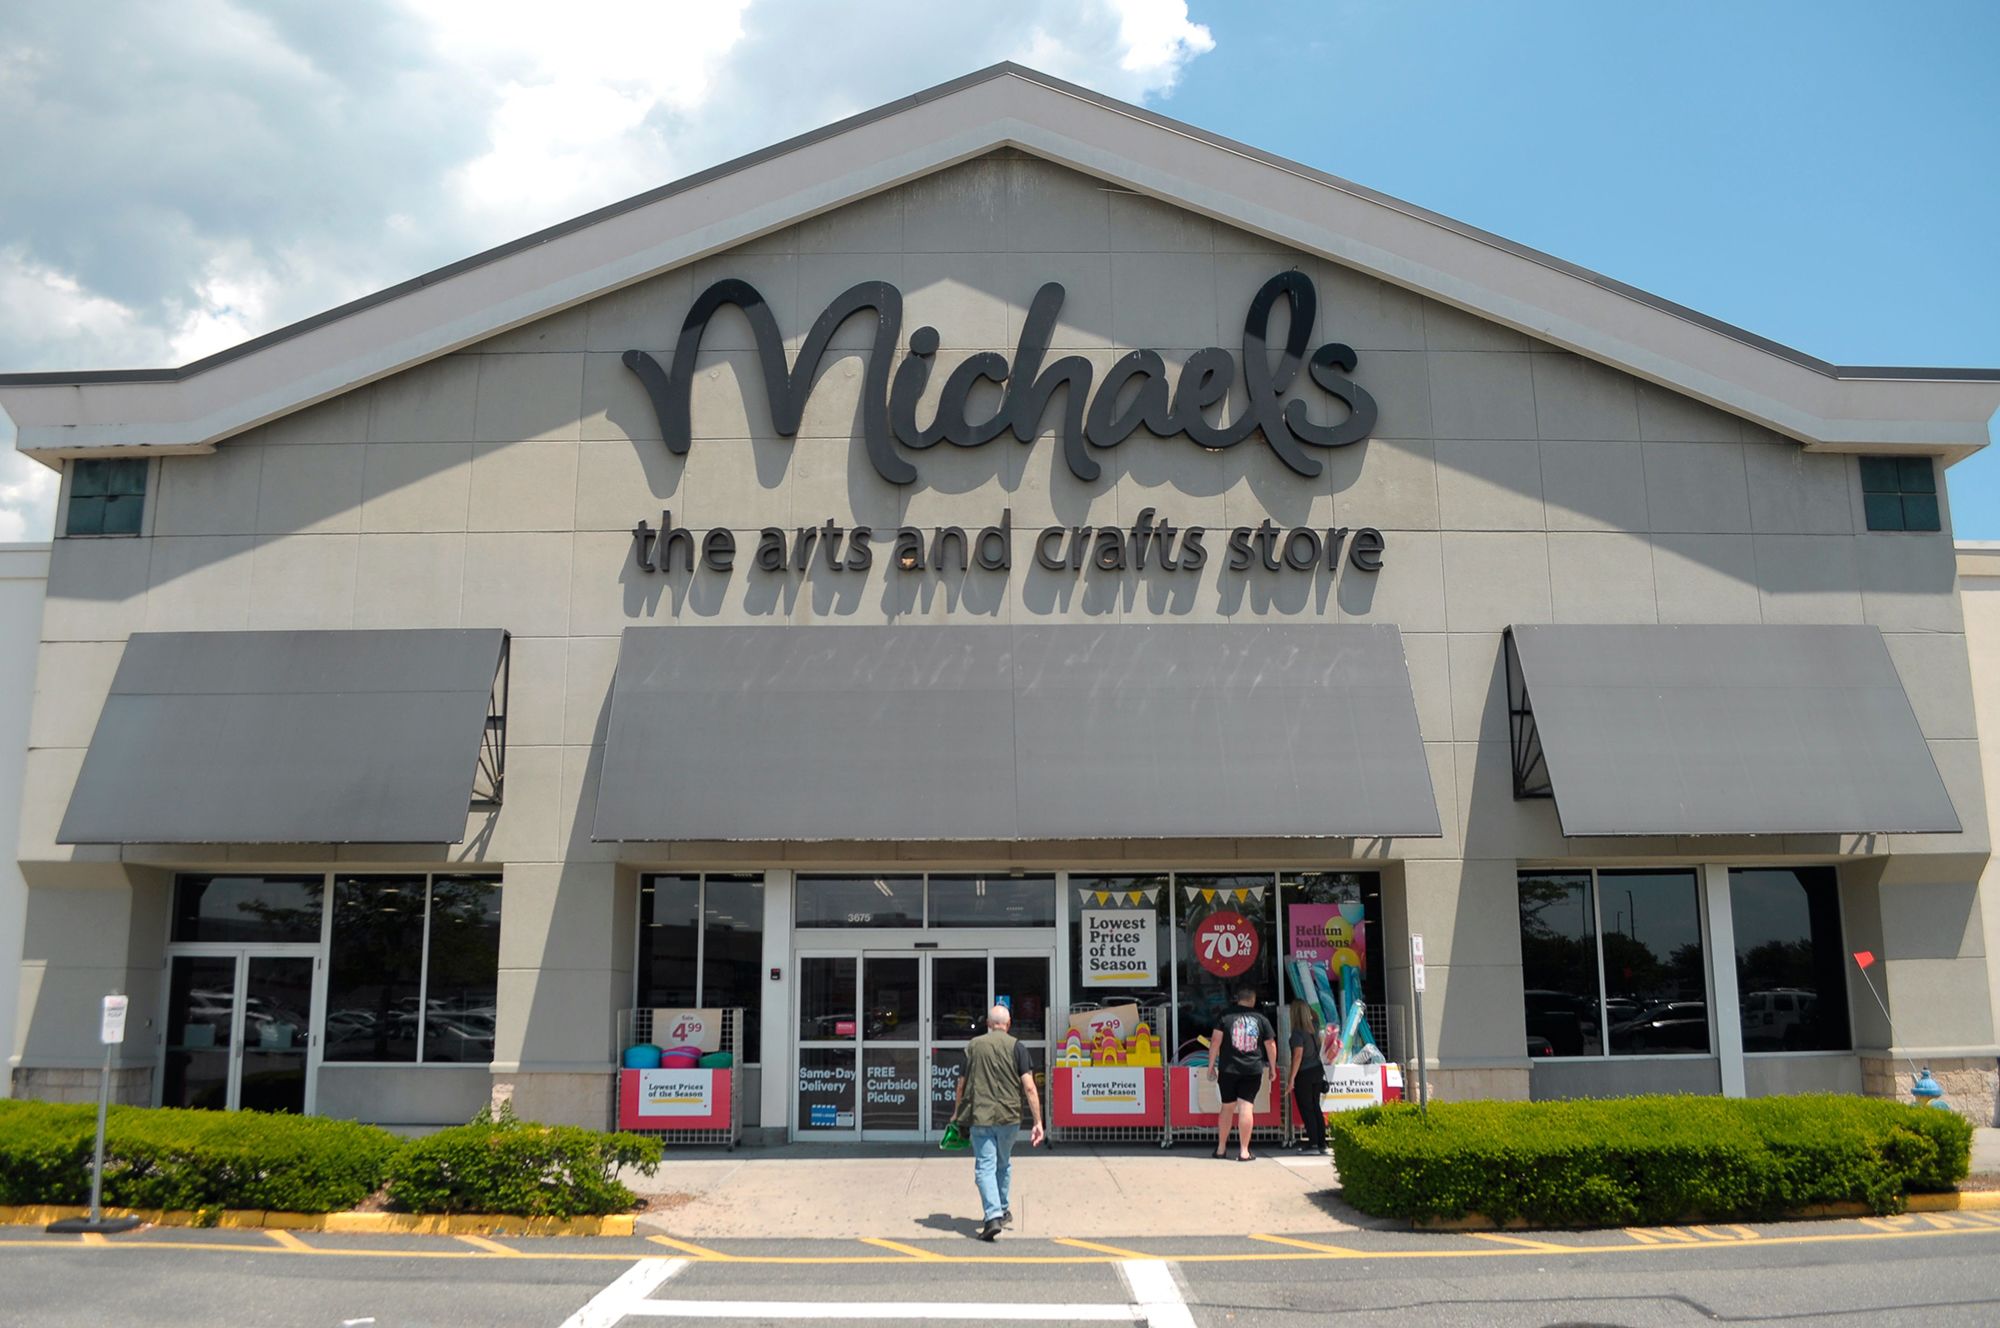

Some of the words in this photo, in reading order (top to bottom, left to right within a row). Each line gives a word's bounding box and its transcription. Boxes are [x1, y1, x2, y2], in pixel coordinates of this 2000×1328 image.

[621, 269, 1378, 485] Michaels
[633, 510, 736, 573] the
[756, 517, 871, 571] arts
[895, 508, 1011, 572] and
[1035, 507, 1206, 572] crafts
[1229, 518, 1385, 572] store
[848, 913, 871, 922] 3675
[1089, 917, 1146, 930] Lowest
[1214, 924, 1225, 932] up
[1296, 925, 1342, 936] Helium
[1090, 930, 1140, 943] Prices
[1201, 932, 1252, 960] 70%
[1296, 937, 1350, 948] balloons
[1090, 944, 1106, 957] of
[1110, 944, 1136, 957] the
[1238, 948, 1251, 956] off
[1296, 949, 1317, 959] are
[1090, 958, 1147, 971] Season
[799, 1067, 856, 1082] Same-Day
[867, 1067, 896, 1078] FREE
[648, 1083, 676, 1091] Lowest
[799, 1081, 846, 1093] Delivery
[867, 1079, 918, 1090] Curbside
[932, 1077, 955, 1088] Pick
[1081, 1081, 1109, 1089] Lowest
[1111, 1081, 1137, 1089] Prices
[674, 1090, 703, 1098] Season
[1345, 1086, 1374, 1094] Season
[867, 1092, 906, 1105] Pickup
